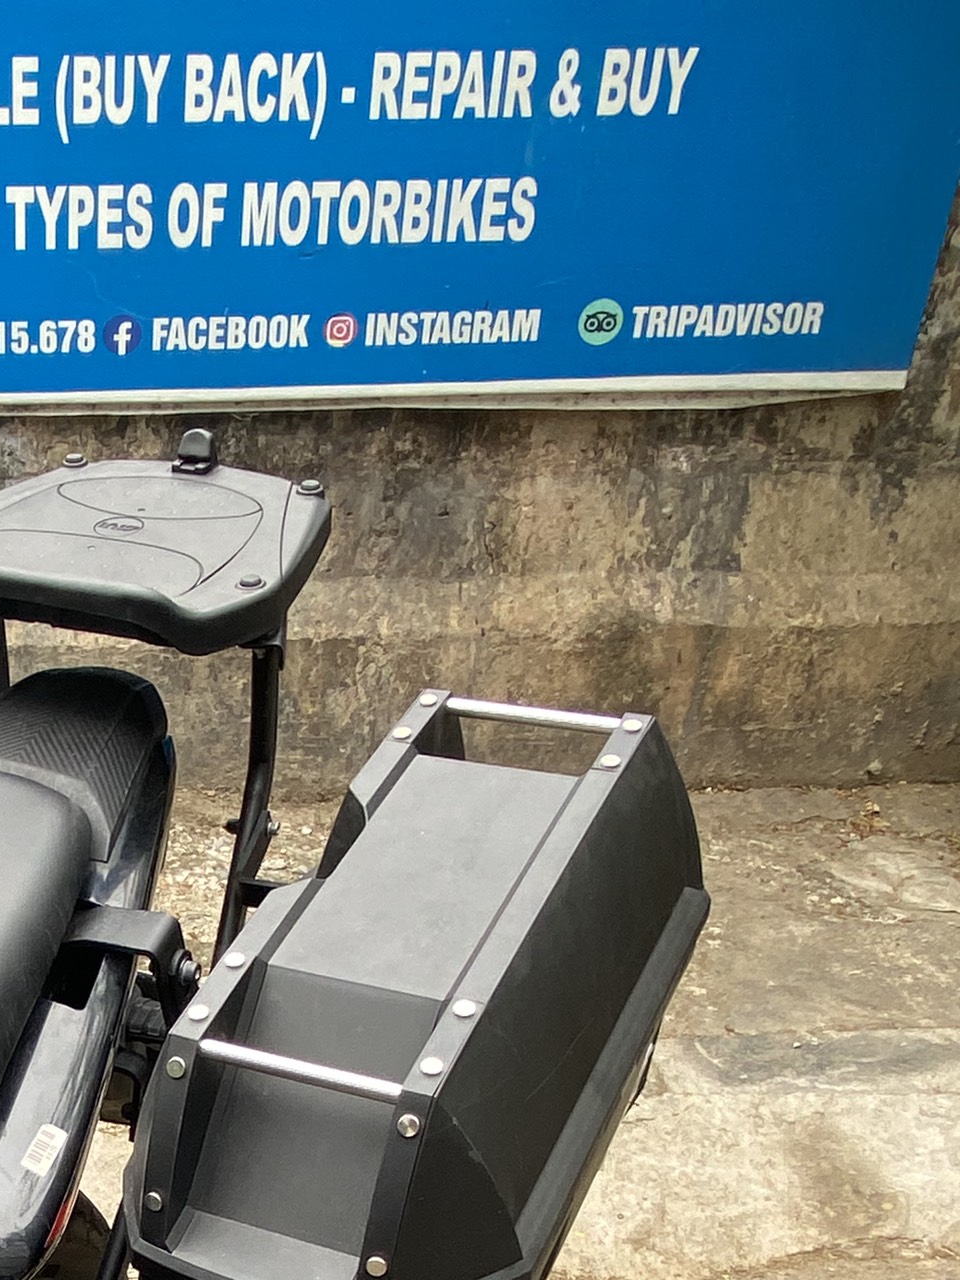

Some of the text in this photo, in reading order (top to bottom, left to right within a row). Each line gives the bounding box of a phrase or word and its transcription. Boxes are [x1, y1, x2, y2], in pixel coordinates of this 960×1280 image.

[56, 55, 170, 143] (BUY
[185, 52, 326, 139] BACK)
[370, 50, 536, 119] REPAIR
[550, 49, 581, 117] &
[597, 47, 699, 115] BUY
[6, 184, 152, 250] TYPES
[168, 183, 227, 248] OF
[241, 177, 537, 246] MOTORBIKES
[153, 315, 310, 350] FACEBOOK
[365, 309, 541, 346] INSTAGRAM
[633, 303, 823, 338] TRIPADVISOR
